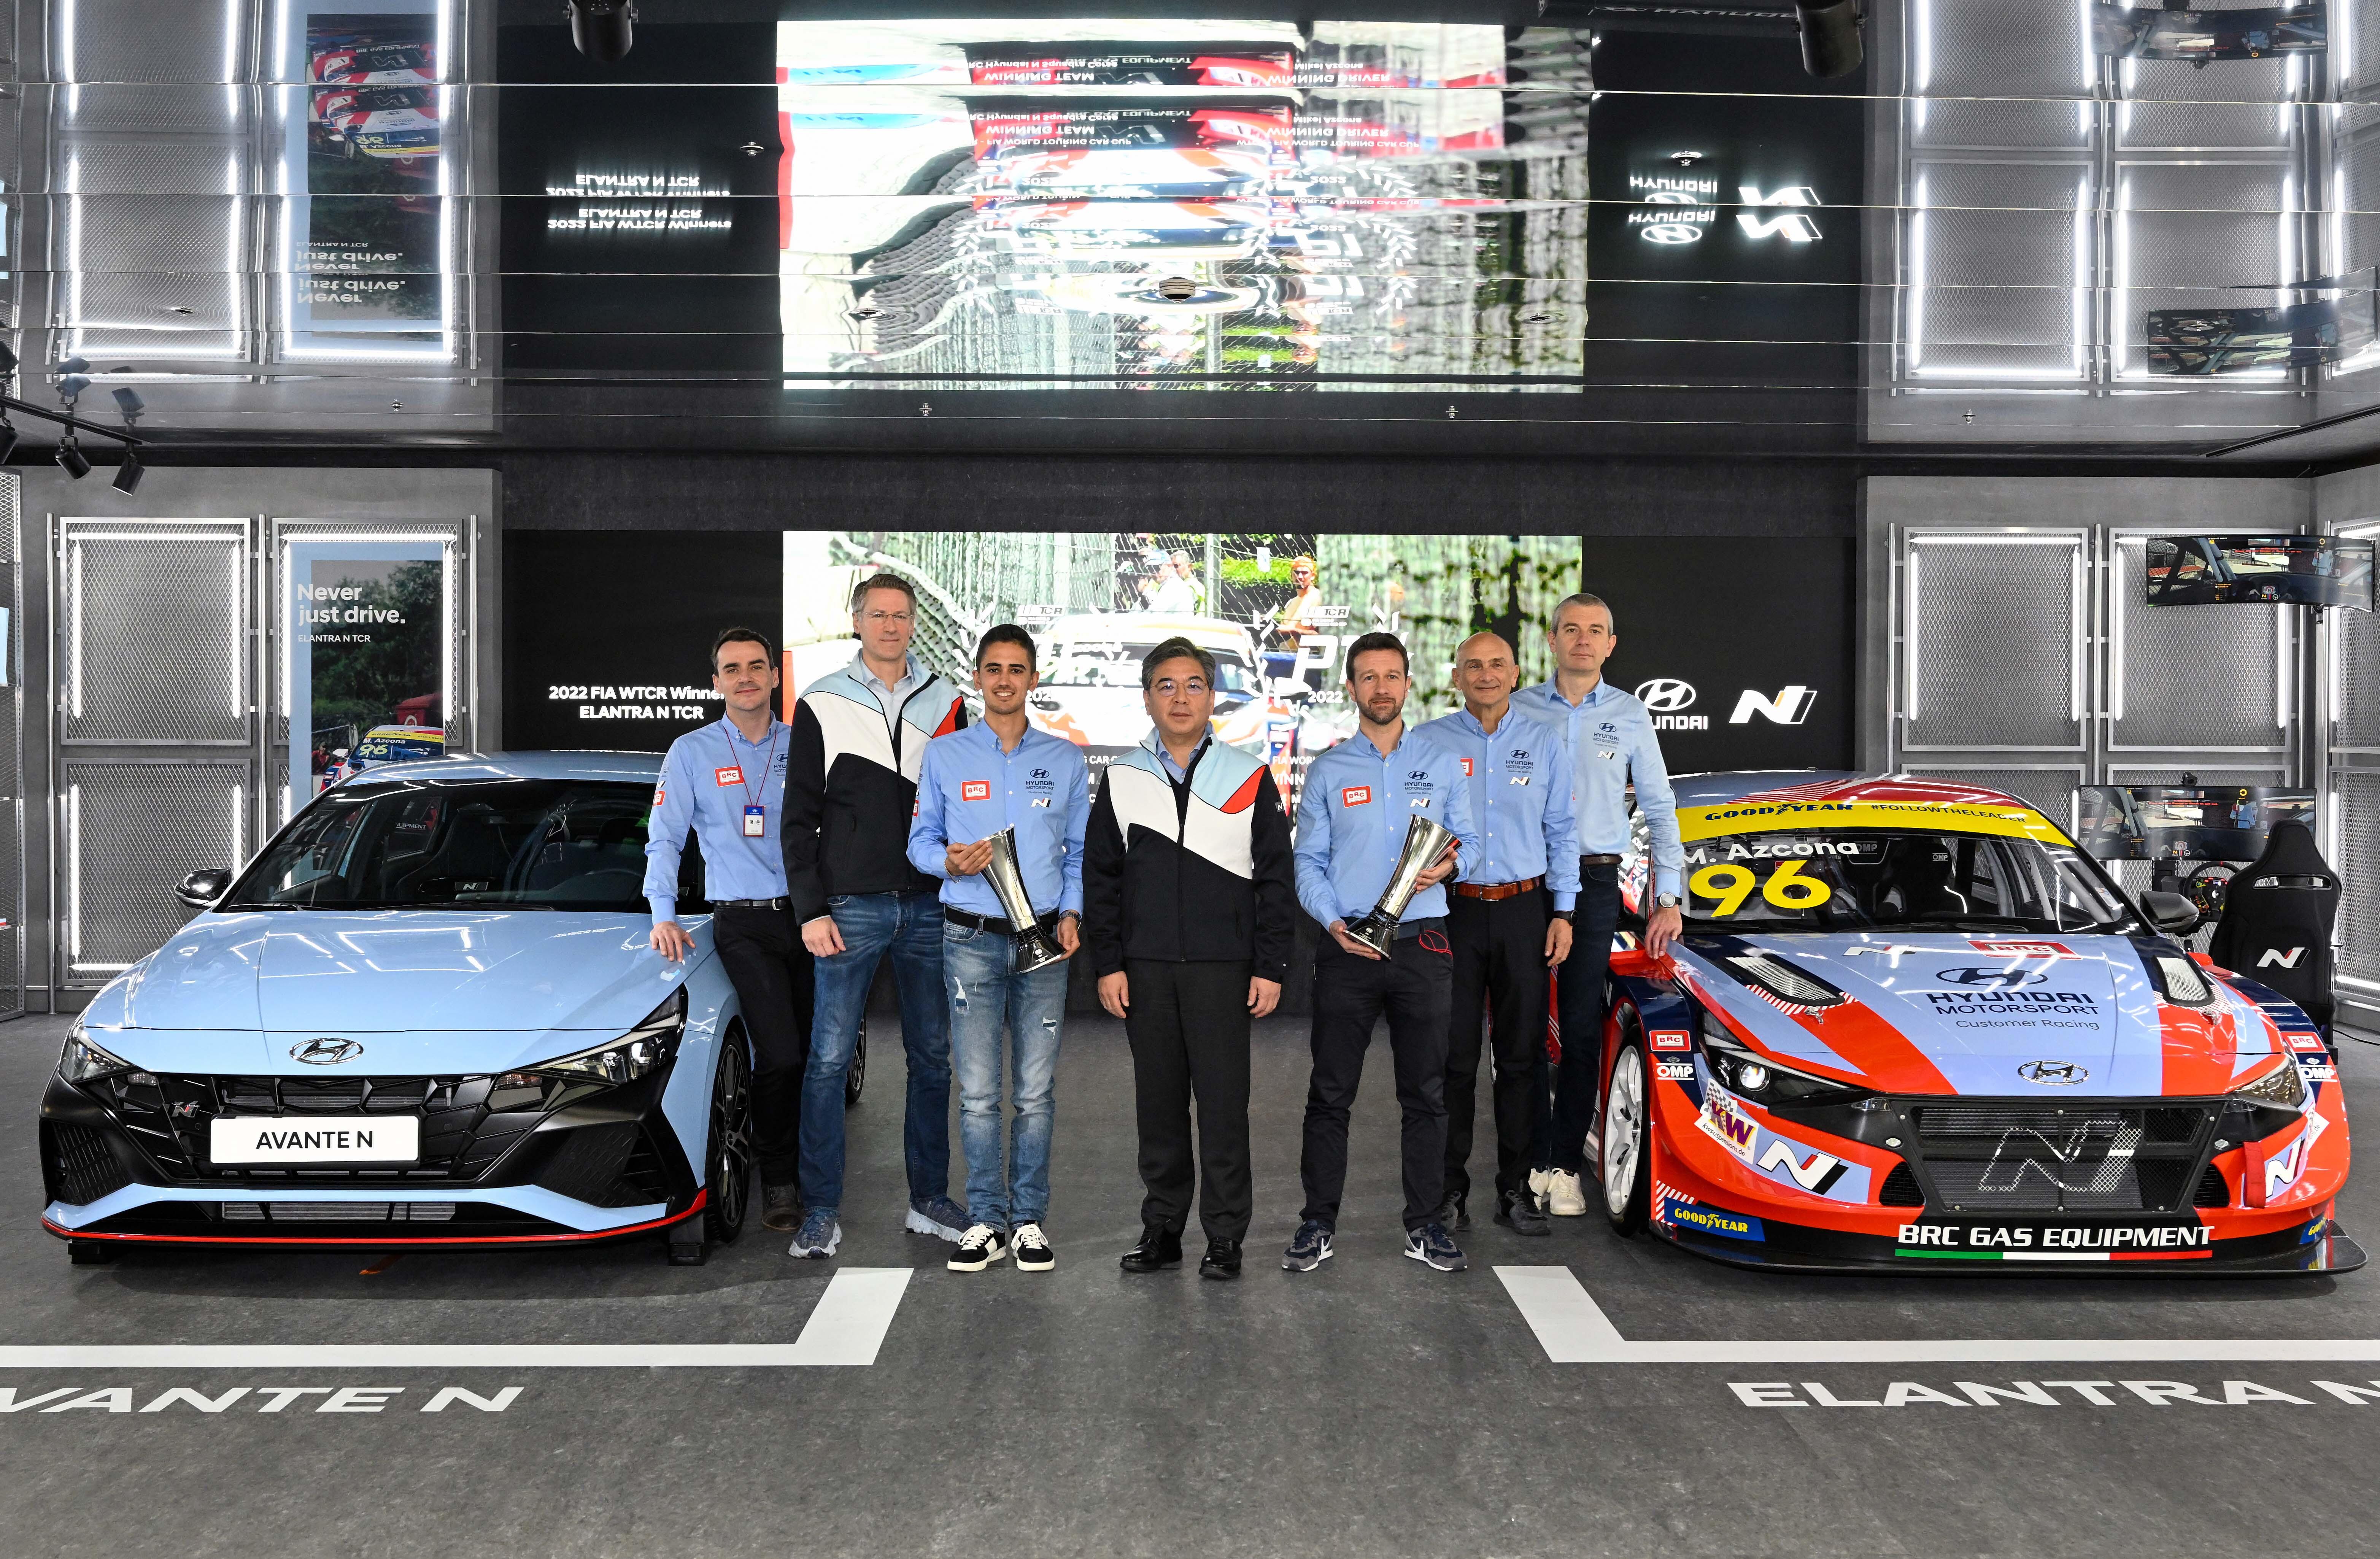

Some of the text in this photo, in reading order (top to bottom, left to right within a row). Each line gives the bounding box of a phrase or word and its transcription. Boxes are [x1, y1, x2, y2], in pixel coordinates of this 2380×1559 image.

[298, 584, 362, 600] Never
[298, 605, 405, 627] just drive.
[549, 686, 588, 700] 2022
[591, 686, 616, 700] FIA
[618, 686, 667, 700] WTCR
[1308, 691, 1343, 703] 2022
[580, 706, 705, 719] ELANTRA N TCR
[1652, 716, 1708, 730] UNDAI
[1594, 732, 1619, 741] HYUNDAI
[359, 744, 389, 755] 96
[1089, 756, 1109, 764] CAR
[1289, 756, 1316, 765] WOR
[1705, 803, 2026, 823] GOODYEAR #FOLLOWTHELEADER
[1683, 842, 1859, 865] M. Azcona
[1689, 860, 1831, 918] 96
[1926, 992, 2094, 1003] HYUNDAI
[1935, 1005, 2099, 1014] MOTORSPORT
[1956, 1019, 2100, 1030] Customer Racing
[1657, 1066, 1694, 1077] OMP
[2302, 1067, 2335, 1079] OMP
[1708, 1098, 1756, 1148] KW
[256, 1131, 373, 1149] AVANTE N
[1702, 1123, 1745, 1157] kwsuspensions.de
[1674, 1208, 1748, 1232] GOODYEAR
[1898, 1225, 2215, 1249] BRC GAS EQUIPMENT
[0, 1387, 524, 1412] VANTE N
[1727, 1380, 2380, 1406] ELANTRA N
